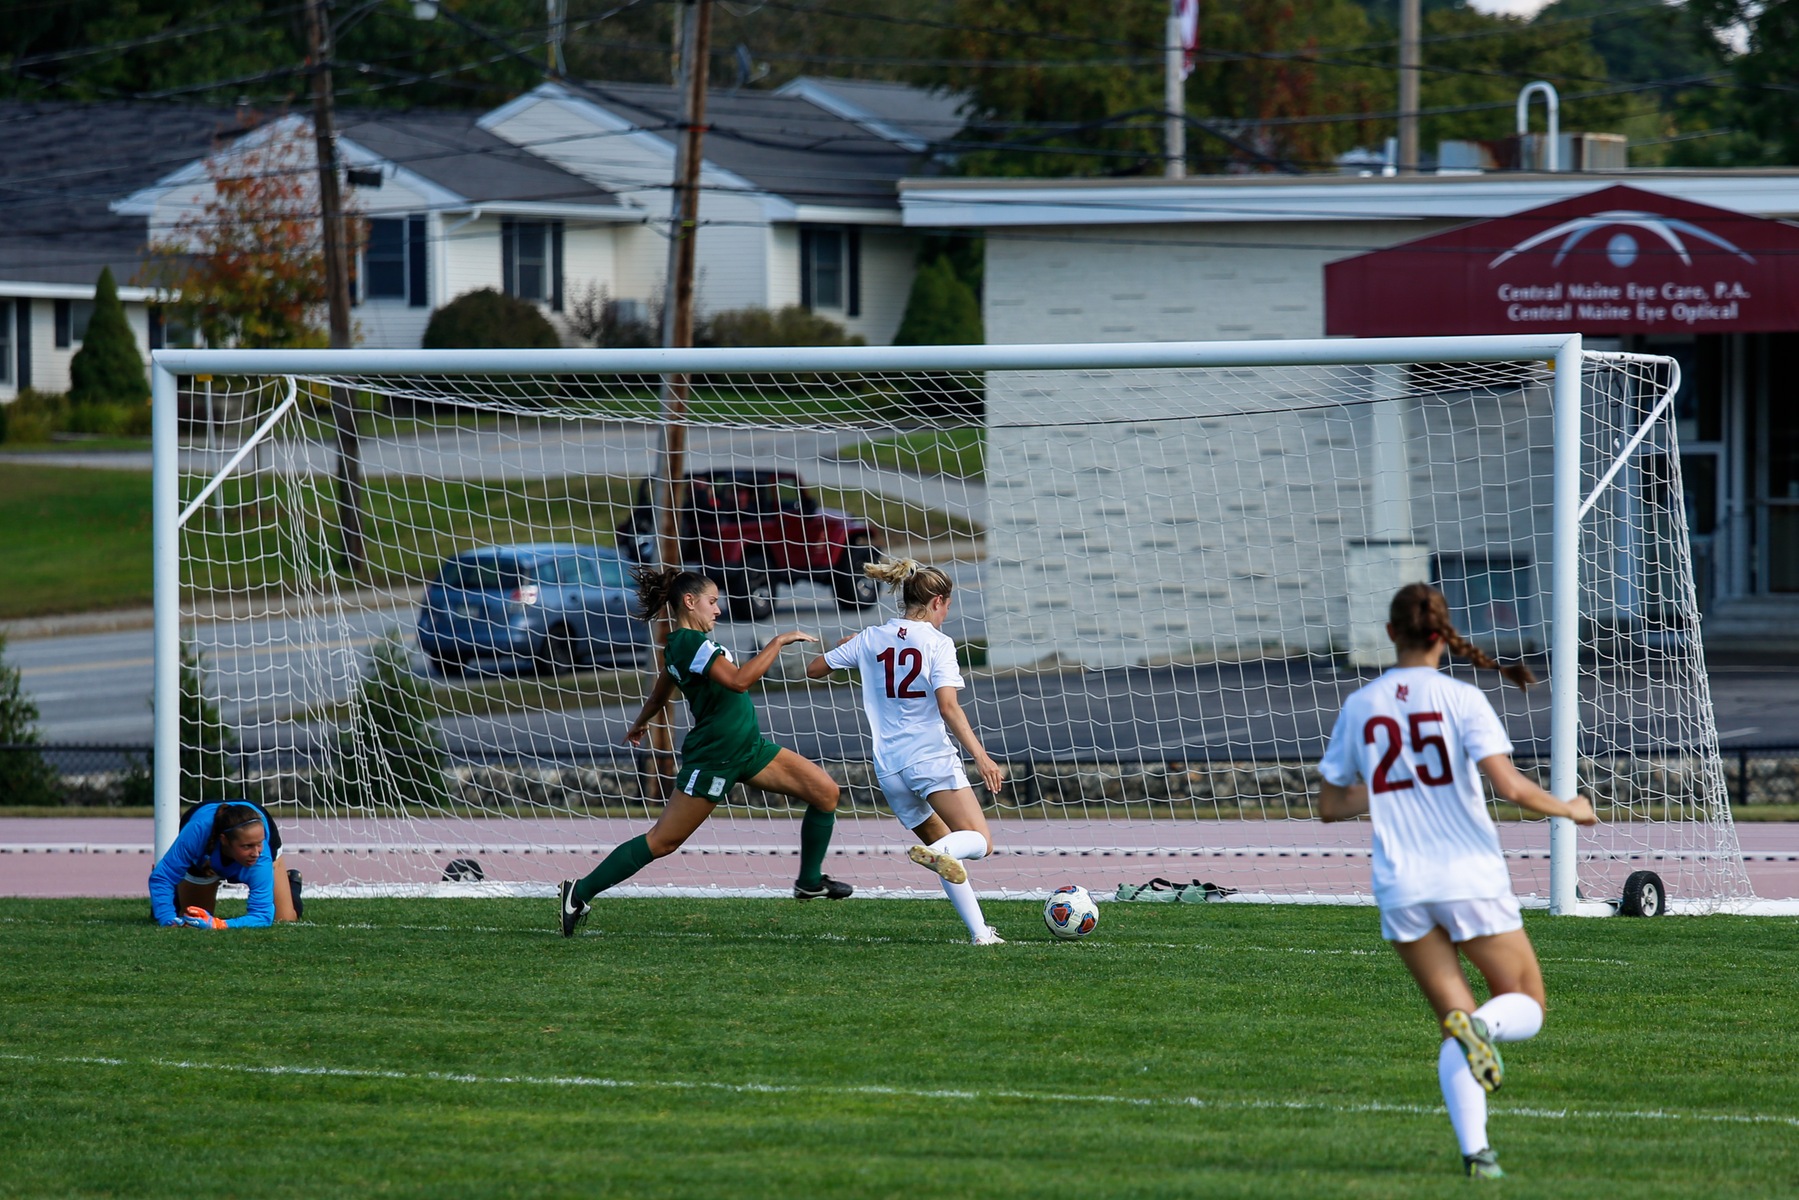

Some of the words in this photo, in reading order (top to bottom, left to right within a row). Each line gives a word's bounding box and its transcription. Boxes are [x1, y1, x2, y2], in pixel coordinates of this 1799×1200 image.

[1498, 282, 1562, 301] Central
[1568, 281, 1621, 300] Maine
[1626, 282, 1657, 303] Eye
[1661, 282, 1709, 300] Care,
[1714, 281, 1751, 299] P.A.
[1507, 302, 1572, 321] Central
[1577, 302, 1631, 320] Maine
[1636, 302, 1667, 325] Eye
[1671, 301, 1738, 325] Optical
[876, 647, 927, 698] 12
[1363, 711, 1453, 795] 25
